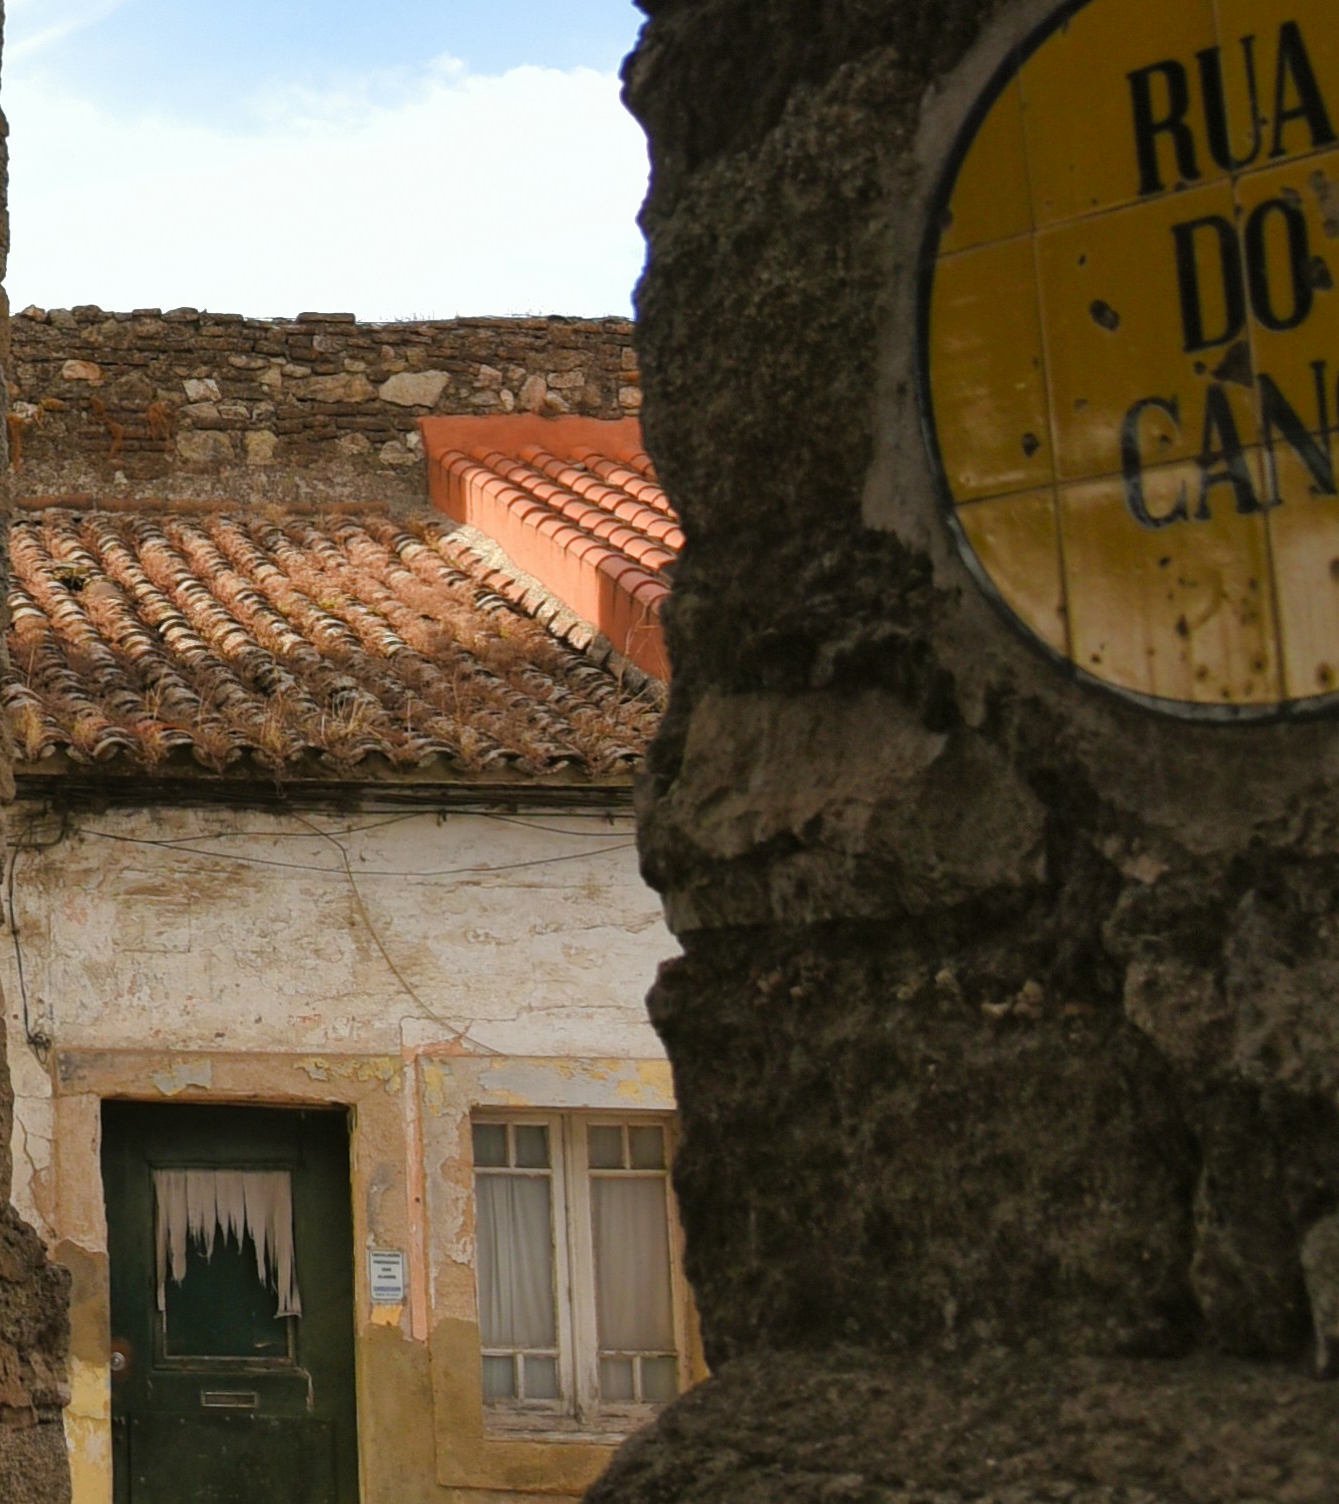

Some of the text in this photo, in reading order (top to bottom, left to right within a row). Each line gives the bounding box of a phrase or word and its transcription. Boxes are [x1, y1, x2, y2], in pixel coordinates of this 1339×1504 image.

[1126, 20, 1338, 196] RUA
[1171, 198, 1314, 354] DO
[1121, 360, 1339, 530] CAN
